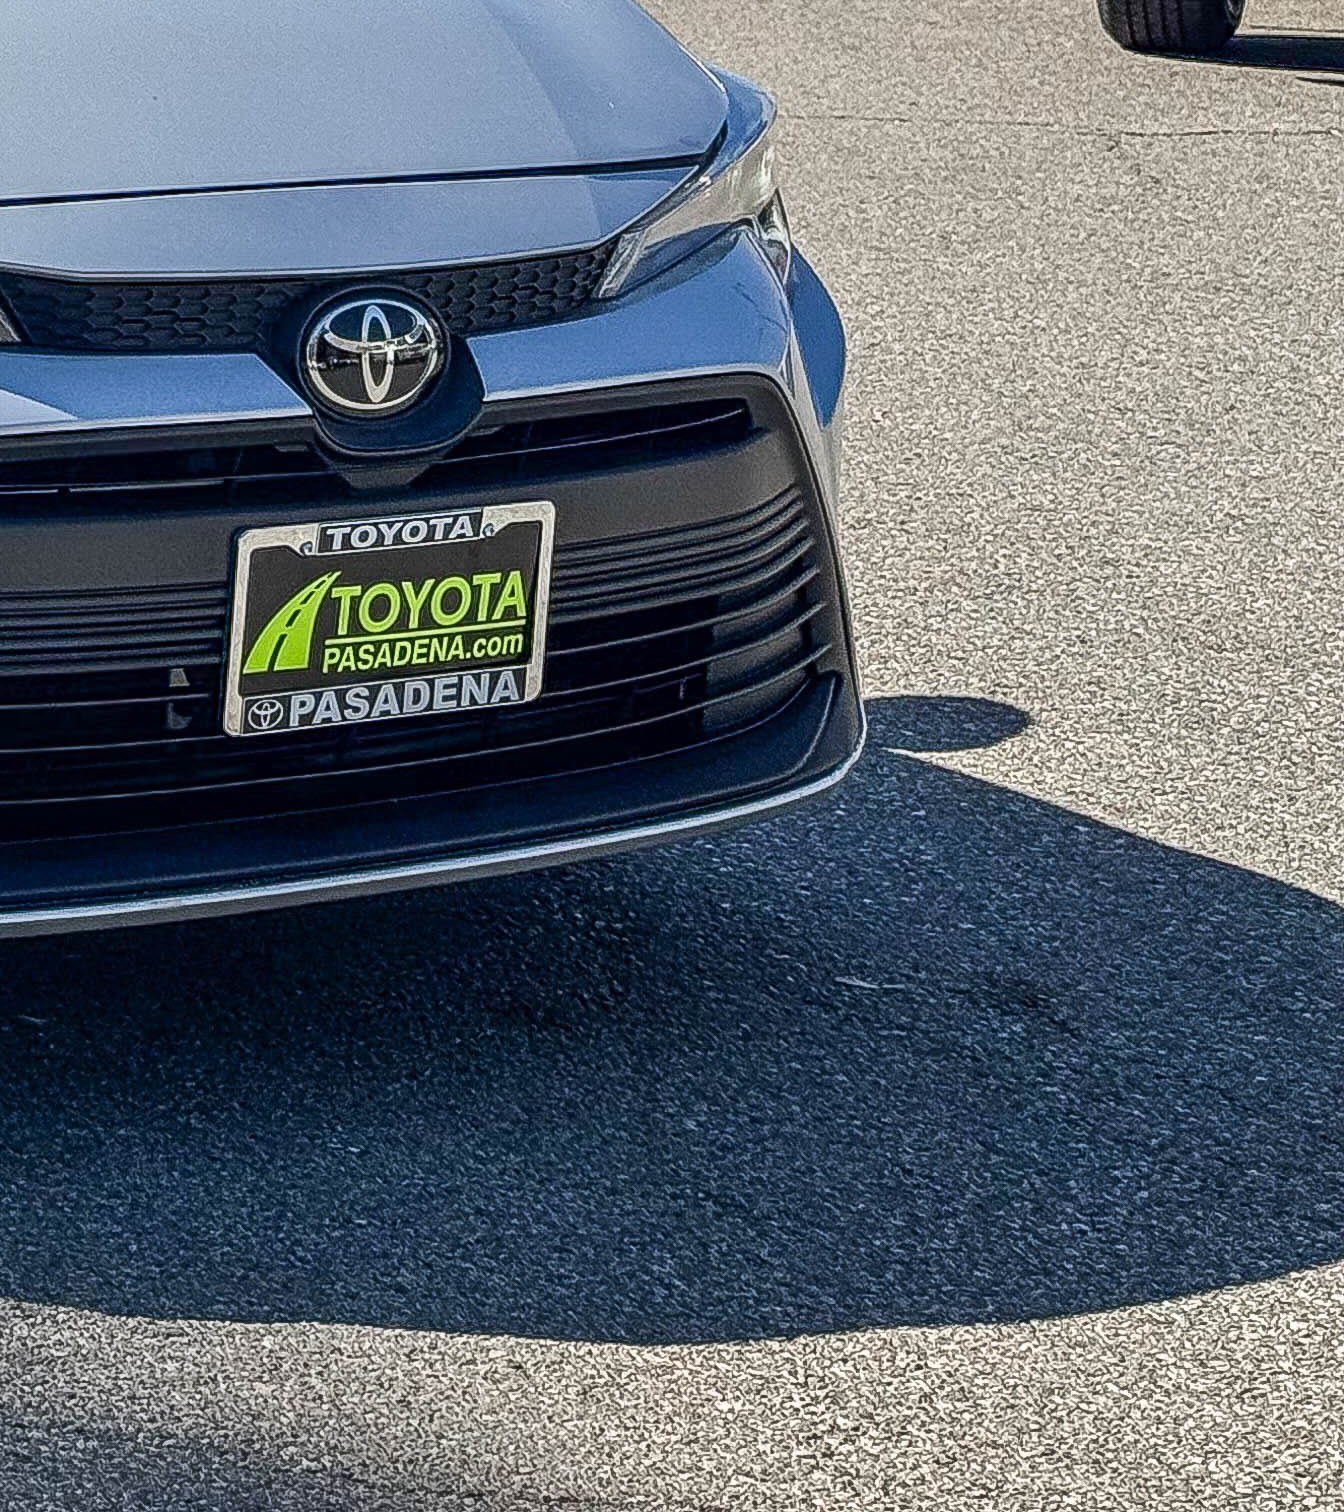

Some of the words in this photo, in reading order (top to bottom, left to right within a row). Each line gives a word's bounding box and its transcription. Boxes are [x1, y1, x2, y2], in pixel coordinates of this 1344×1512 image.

[326, 515, 473, 550] TOYOTA
[330, 570, 526, 635] TOYOTA
[322, 633, 523, 674] PASADENA.com
[289, 670, 519, 726] PASADENA
